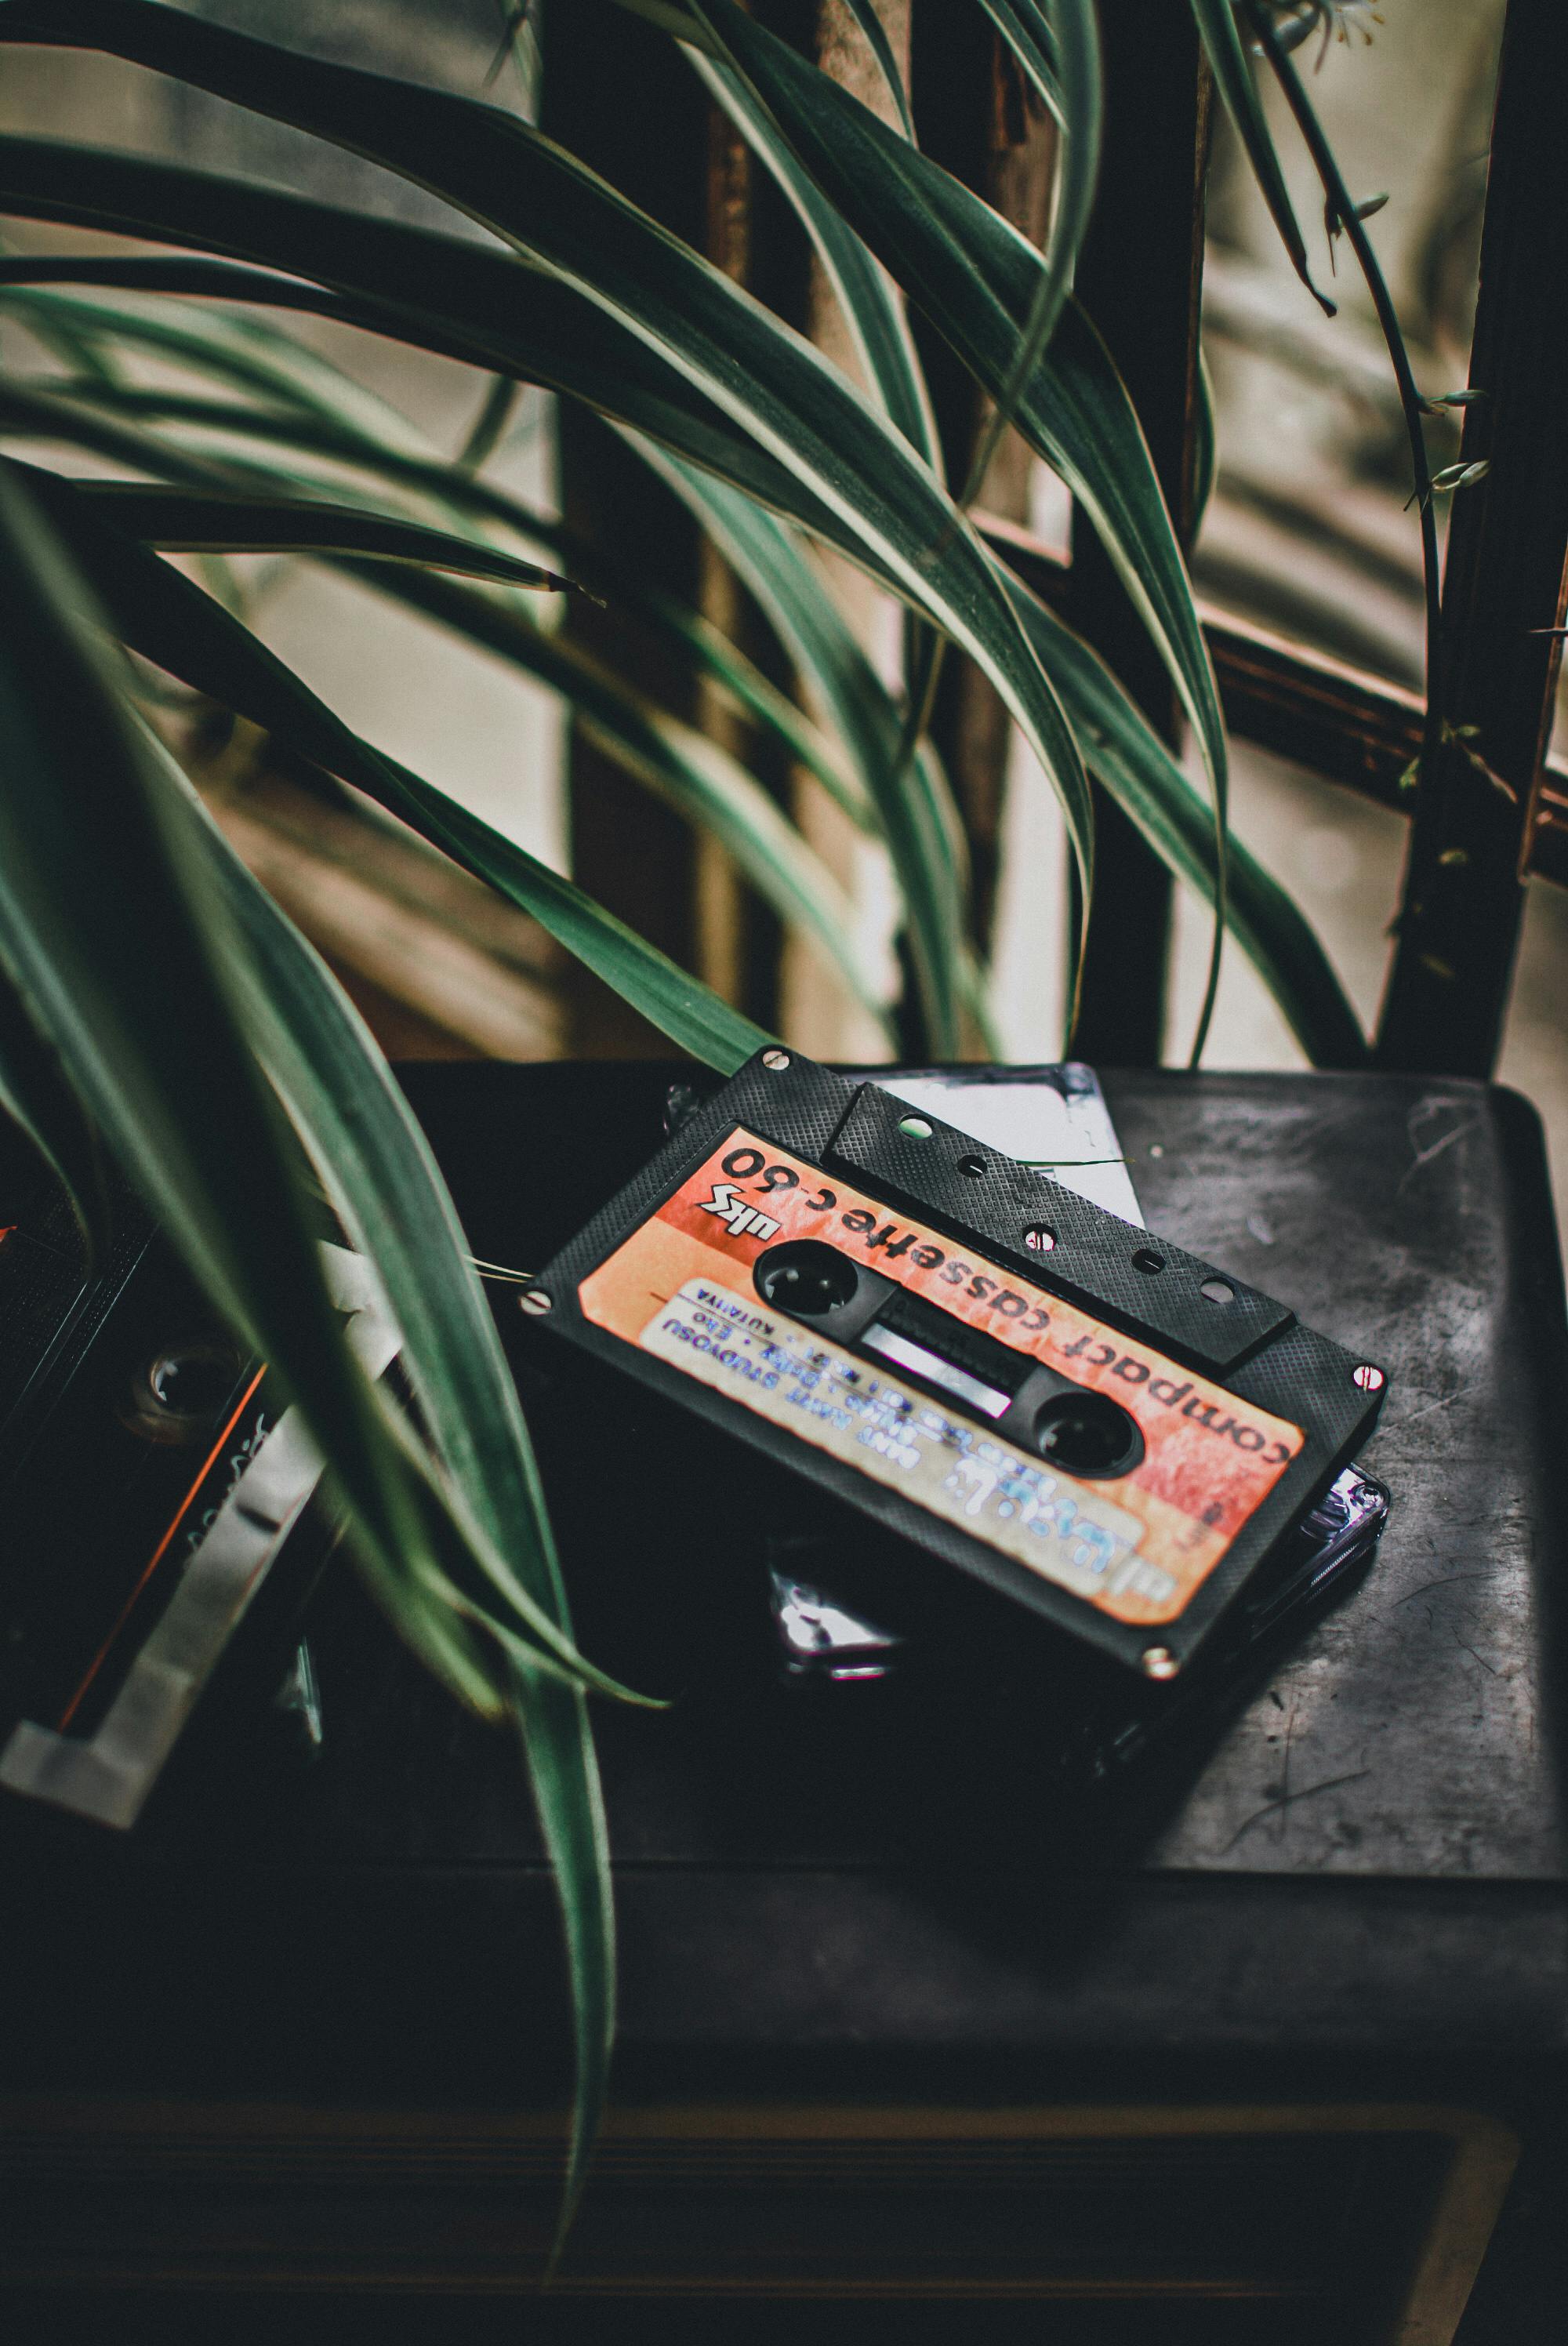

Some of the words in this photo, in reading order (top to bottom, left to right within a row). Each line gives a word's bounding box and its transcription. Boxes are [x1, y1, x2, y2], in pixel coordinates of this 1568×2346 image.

[696, 1183, 781, 1241] uks
[840, 1209, 1050, 1330] cassette
[1064, 1336, 1289, 1464] compact
